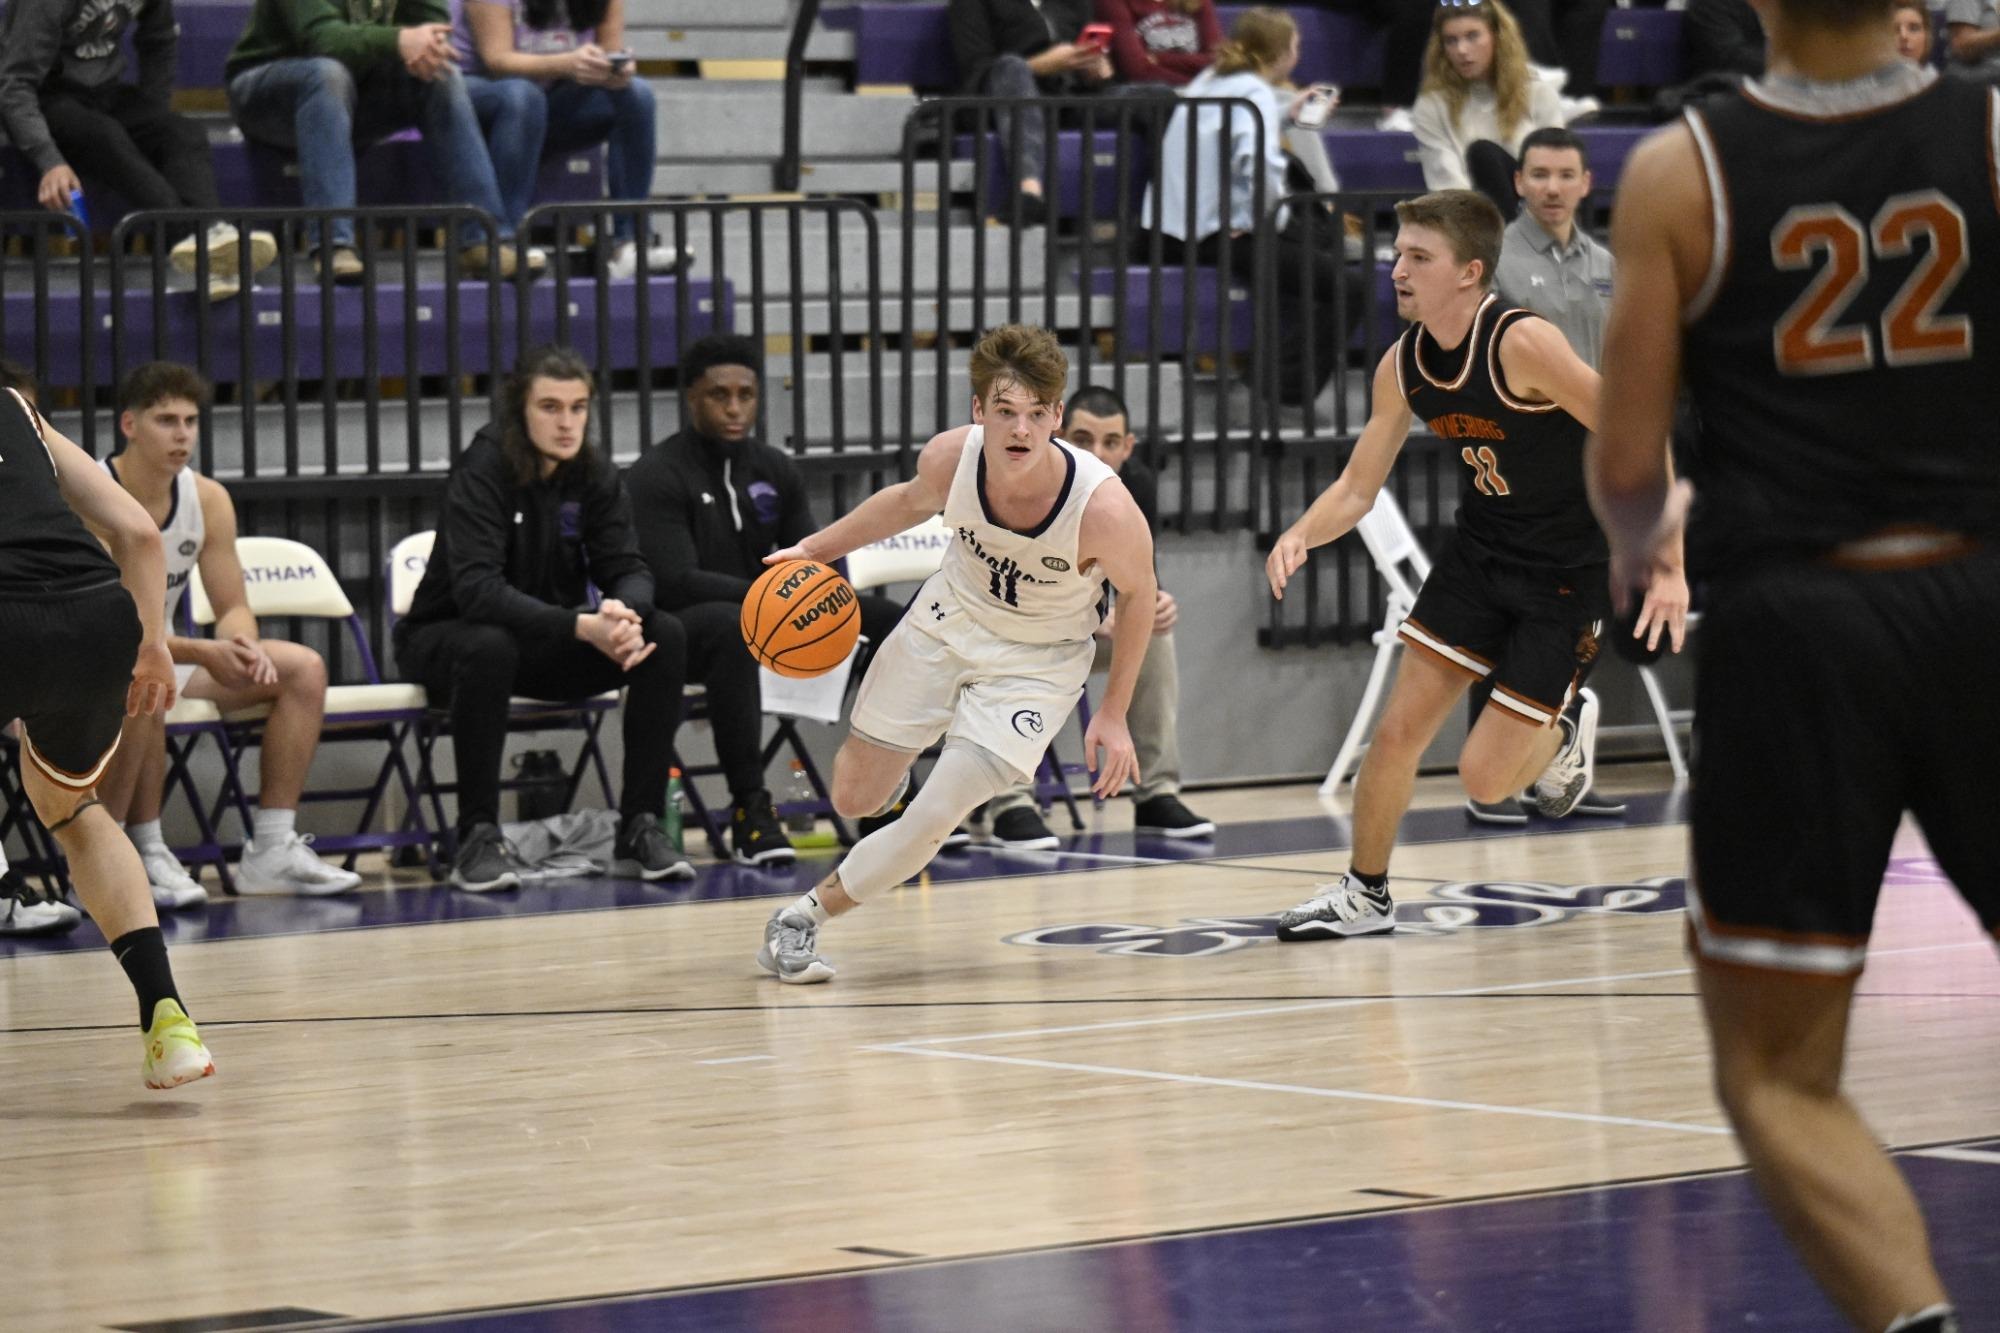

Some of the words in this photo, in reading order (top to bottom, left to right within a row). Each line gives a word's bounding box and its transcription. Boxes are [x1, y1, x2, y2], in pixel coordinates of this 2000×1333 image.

[1770, 187, 1974, 378] 22
[1461, 446, 1511, 496] 11
[243, 565, 316, 583] ATHAM
[776, 563, 821, 599] NCAA
[989, 570, 1018, 608] 11
[791, 583, 853, 631] Wilson
